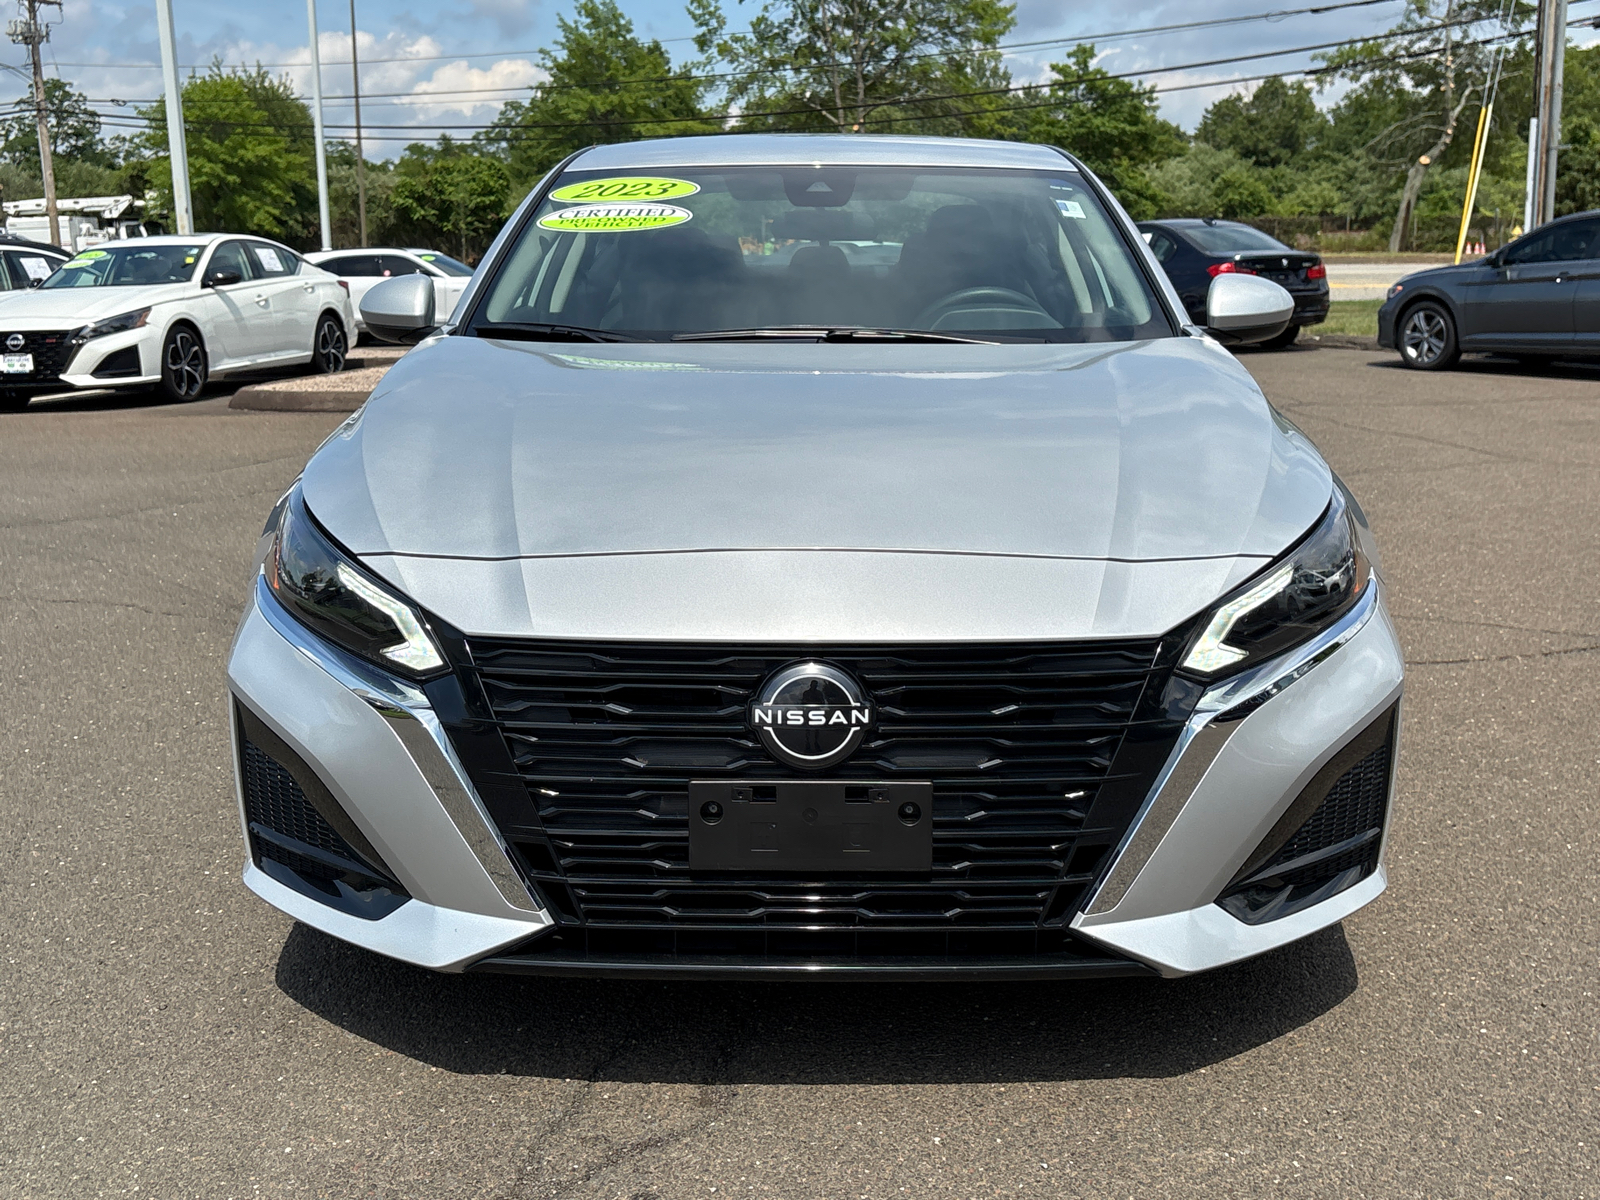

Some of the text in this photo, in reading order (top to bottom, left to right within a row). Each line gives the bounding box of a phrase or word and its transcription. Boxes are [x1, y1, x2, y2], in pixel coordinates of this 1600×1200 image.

[571, 182, 678, 199] 2023
[558, 208, 676, 219] CERTIFIED
[559, 217, 666, 225] PRE-OWNED
[754, 708, 869, 726] NISSAN
